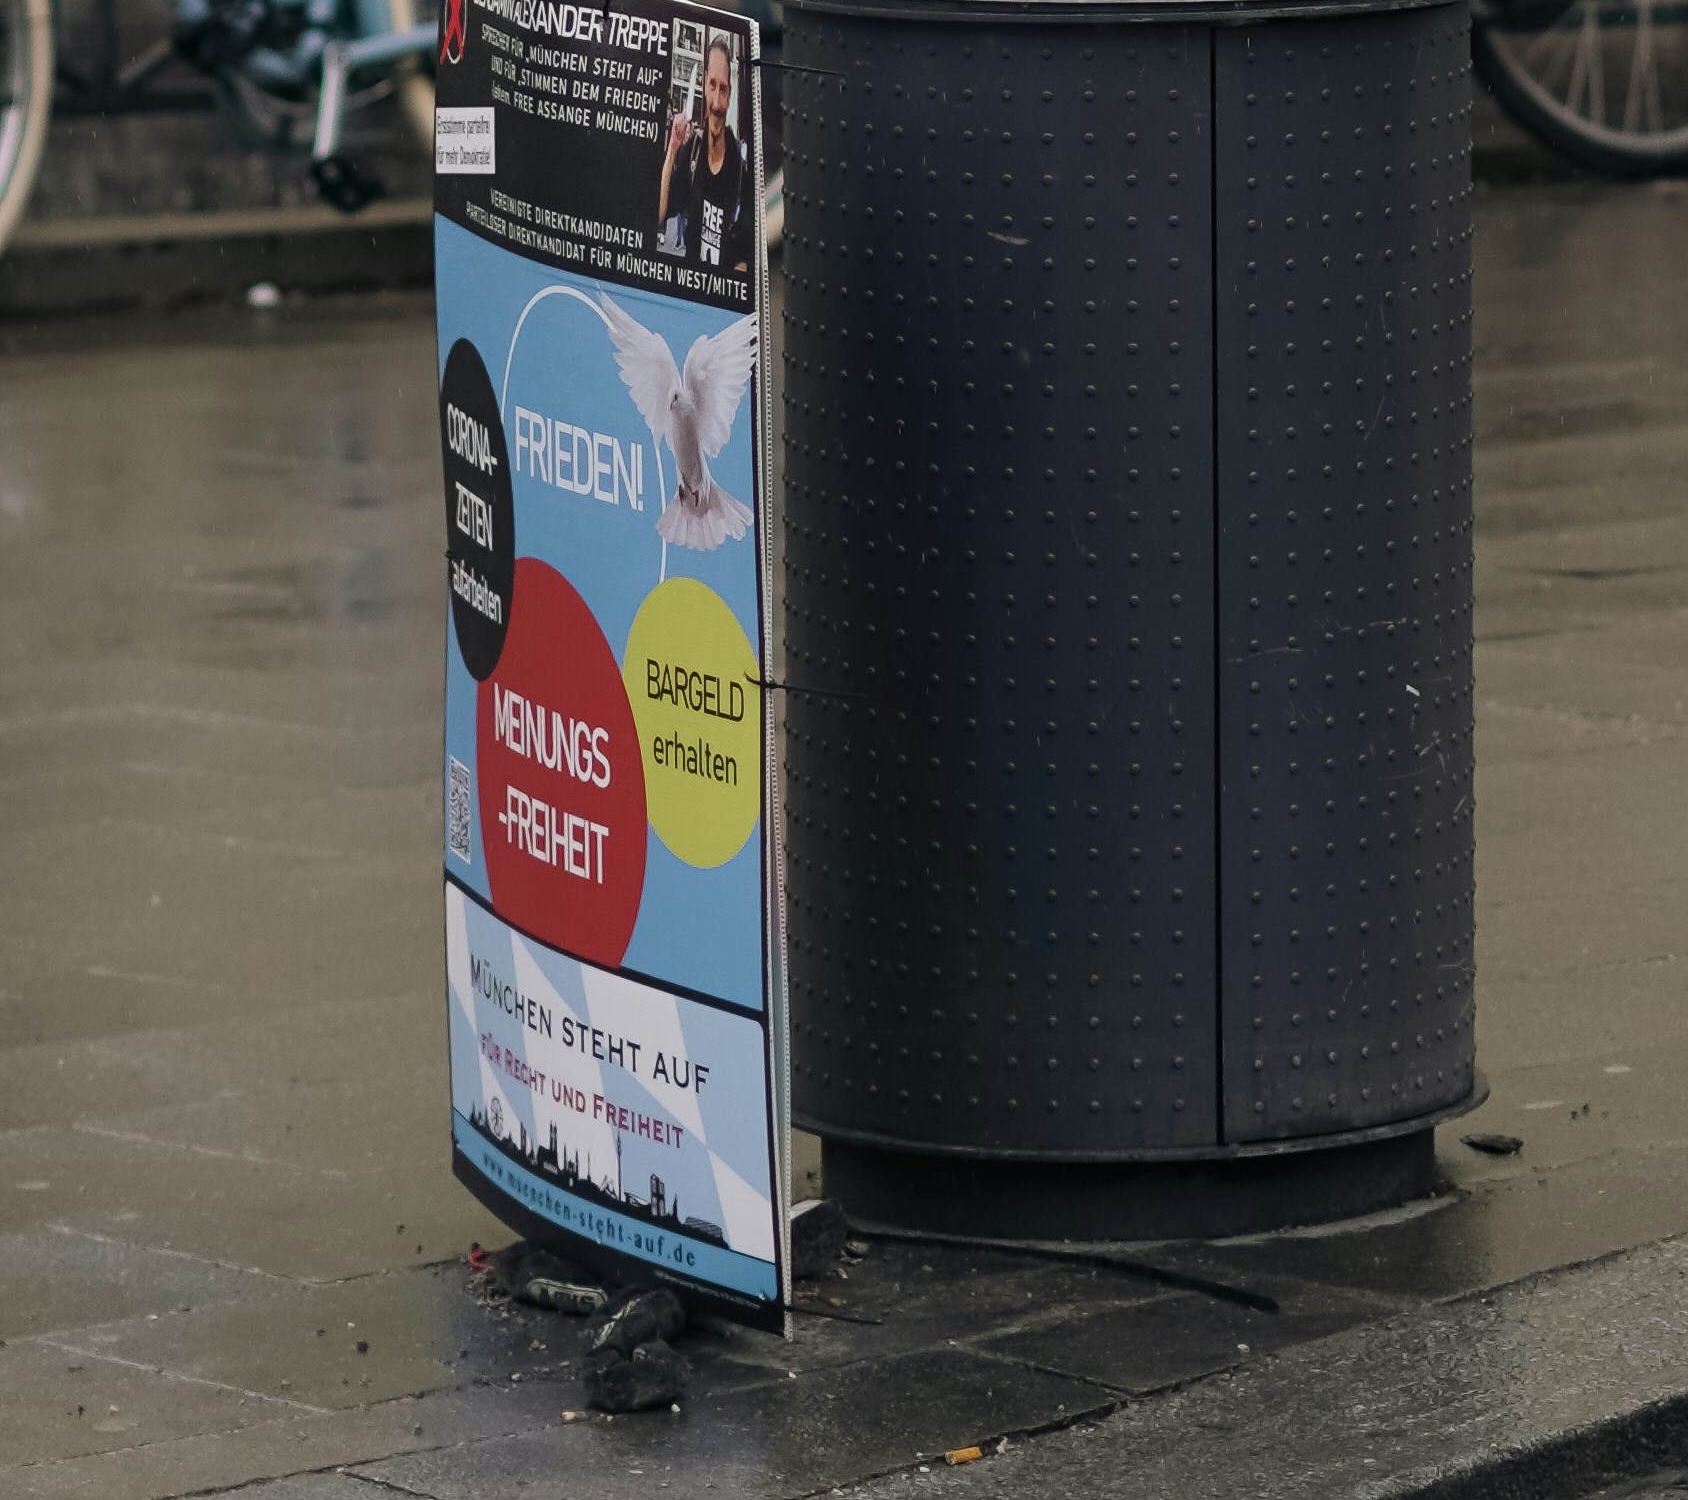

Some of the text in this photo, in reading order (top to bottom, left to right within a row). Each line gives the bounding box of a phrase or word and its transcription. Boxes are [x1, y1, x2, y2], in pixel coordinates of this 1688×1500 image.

[511, 36, 523, 59] FÜR
[593, 58, 632, 81] STEHT
[608, 12, 669, 56] TREPPE
[514, 91, 534, 114] FREE
[537, 99, 591, 127] ASSANGE
[596, 111, 659, 143] MÜNCHEN)
[572, 80, 599, 101] DEM
[535, 206, 643, 249] DIREKTKANDIDATEN
[703, 199, 724, 233] REE
[508, 222, 585, 263] DIREKTKANDIDAT
[590, 246, 611, 269] FÜR
[616, 252, 672, 283] MÜNCHEN
[677, 266, 748, 301] WEST/MITTE
[447, 402, 498, 476] CORONA-
[515, 405, 644, 512] FRIEDEN!
[455, 481, 493, 551] ZEITEN
[451, 559, 502, 625] aufarbeiten
[646, 658, 745, 722] BARGELD
[494, 682, 611, 789] MEINUNGS
[653, 730, 737, 786] erhalten
[498, 784, 609, 885] -FREIHEIT
[470, 954, 710, 1094] MÜNCHEN STEHT AUF
[551, 1077, 586, 1113] UND
[592, 1092, 683, 1149] FREIHEIT
